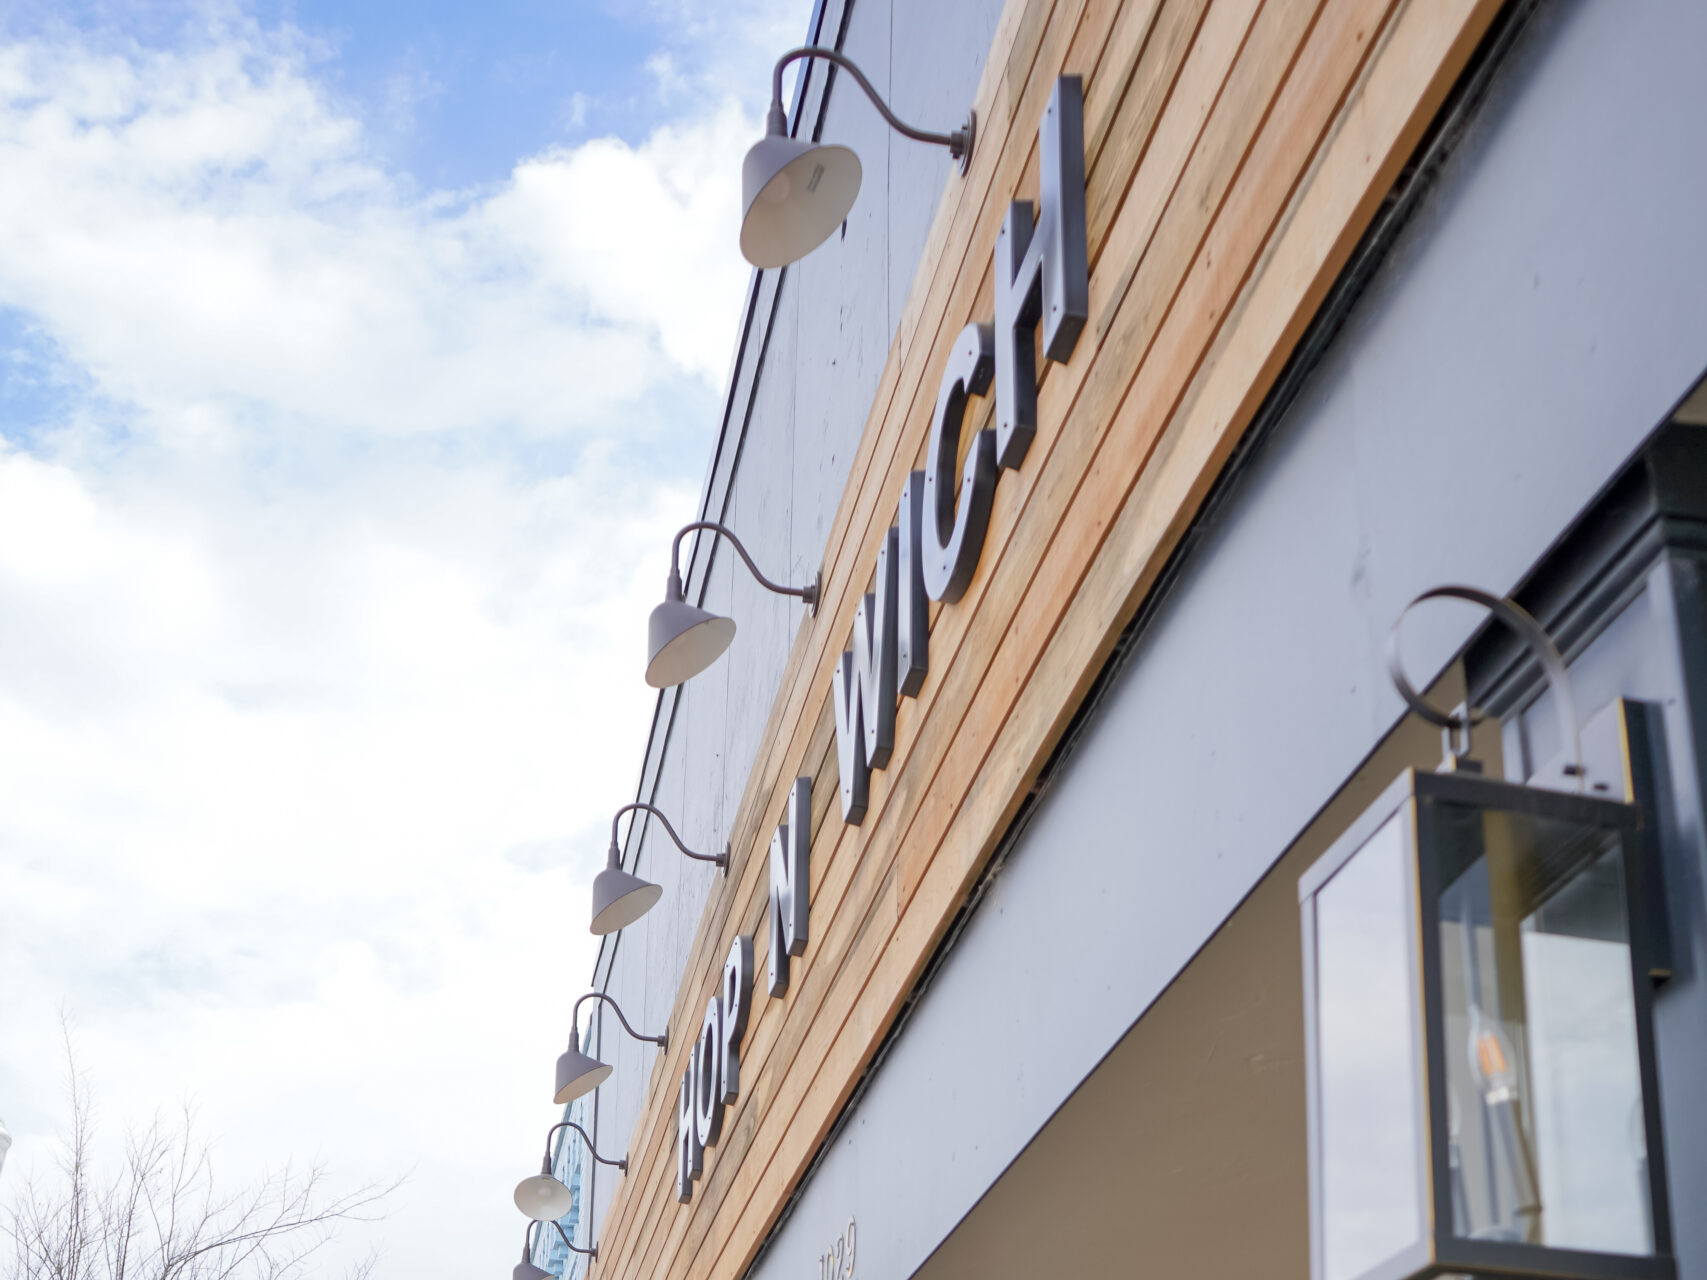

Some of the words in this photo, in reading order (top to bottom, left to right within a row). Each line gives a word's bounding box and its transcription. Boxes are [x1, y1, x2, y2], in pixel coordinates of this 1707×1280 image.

[677, 935, 753, 1204] HOP
[768, 777, 812, 998] N
[833, 74, 1089, 826] WICH
